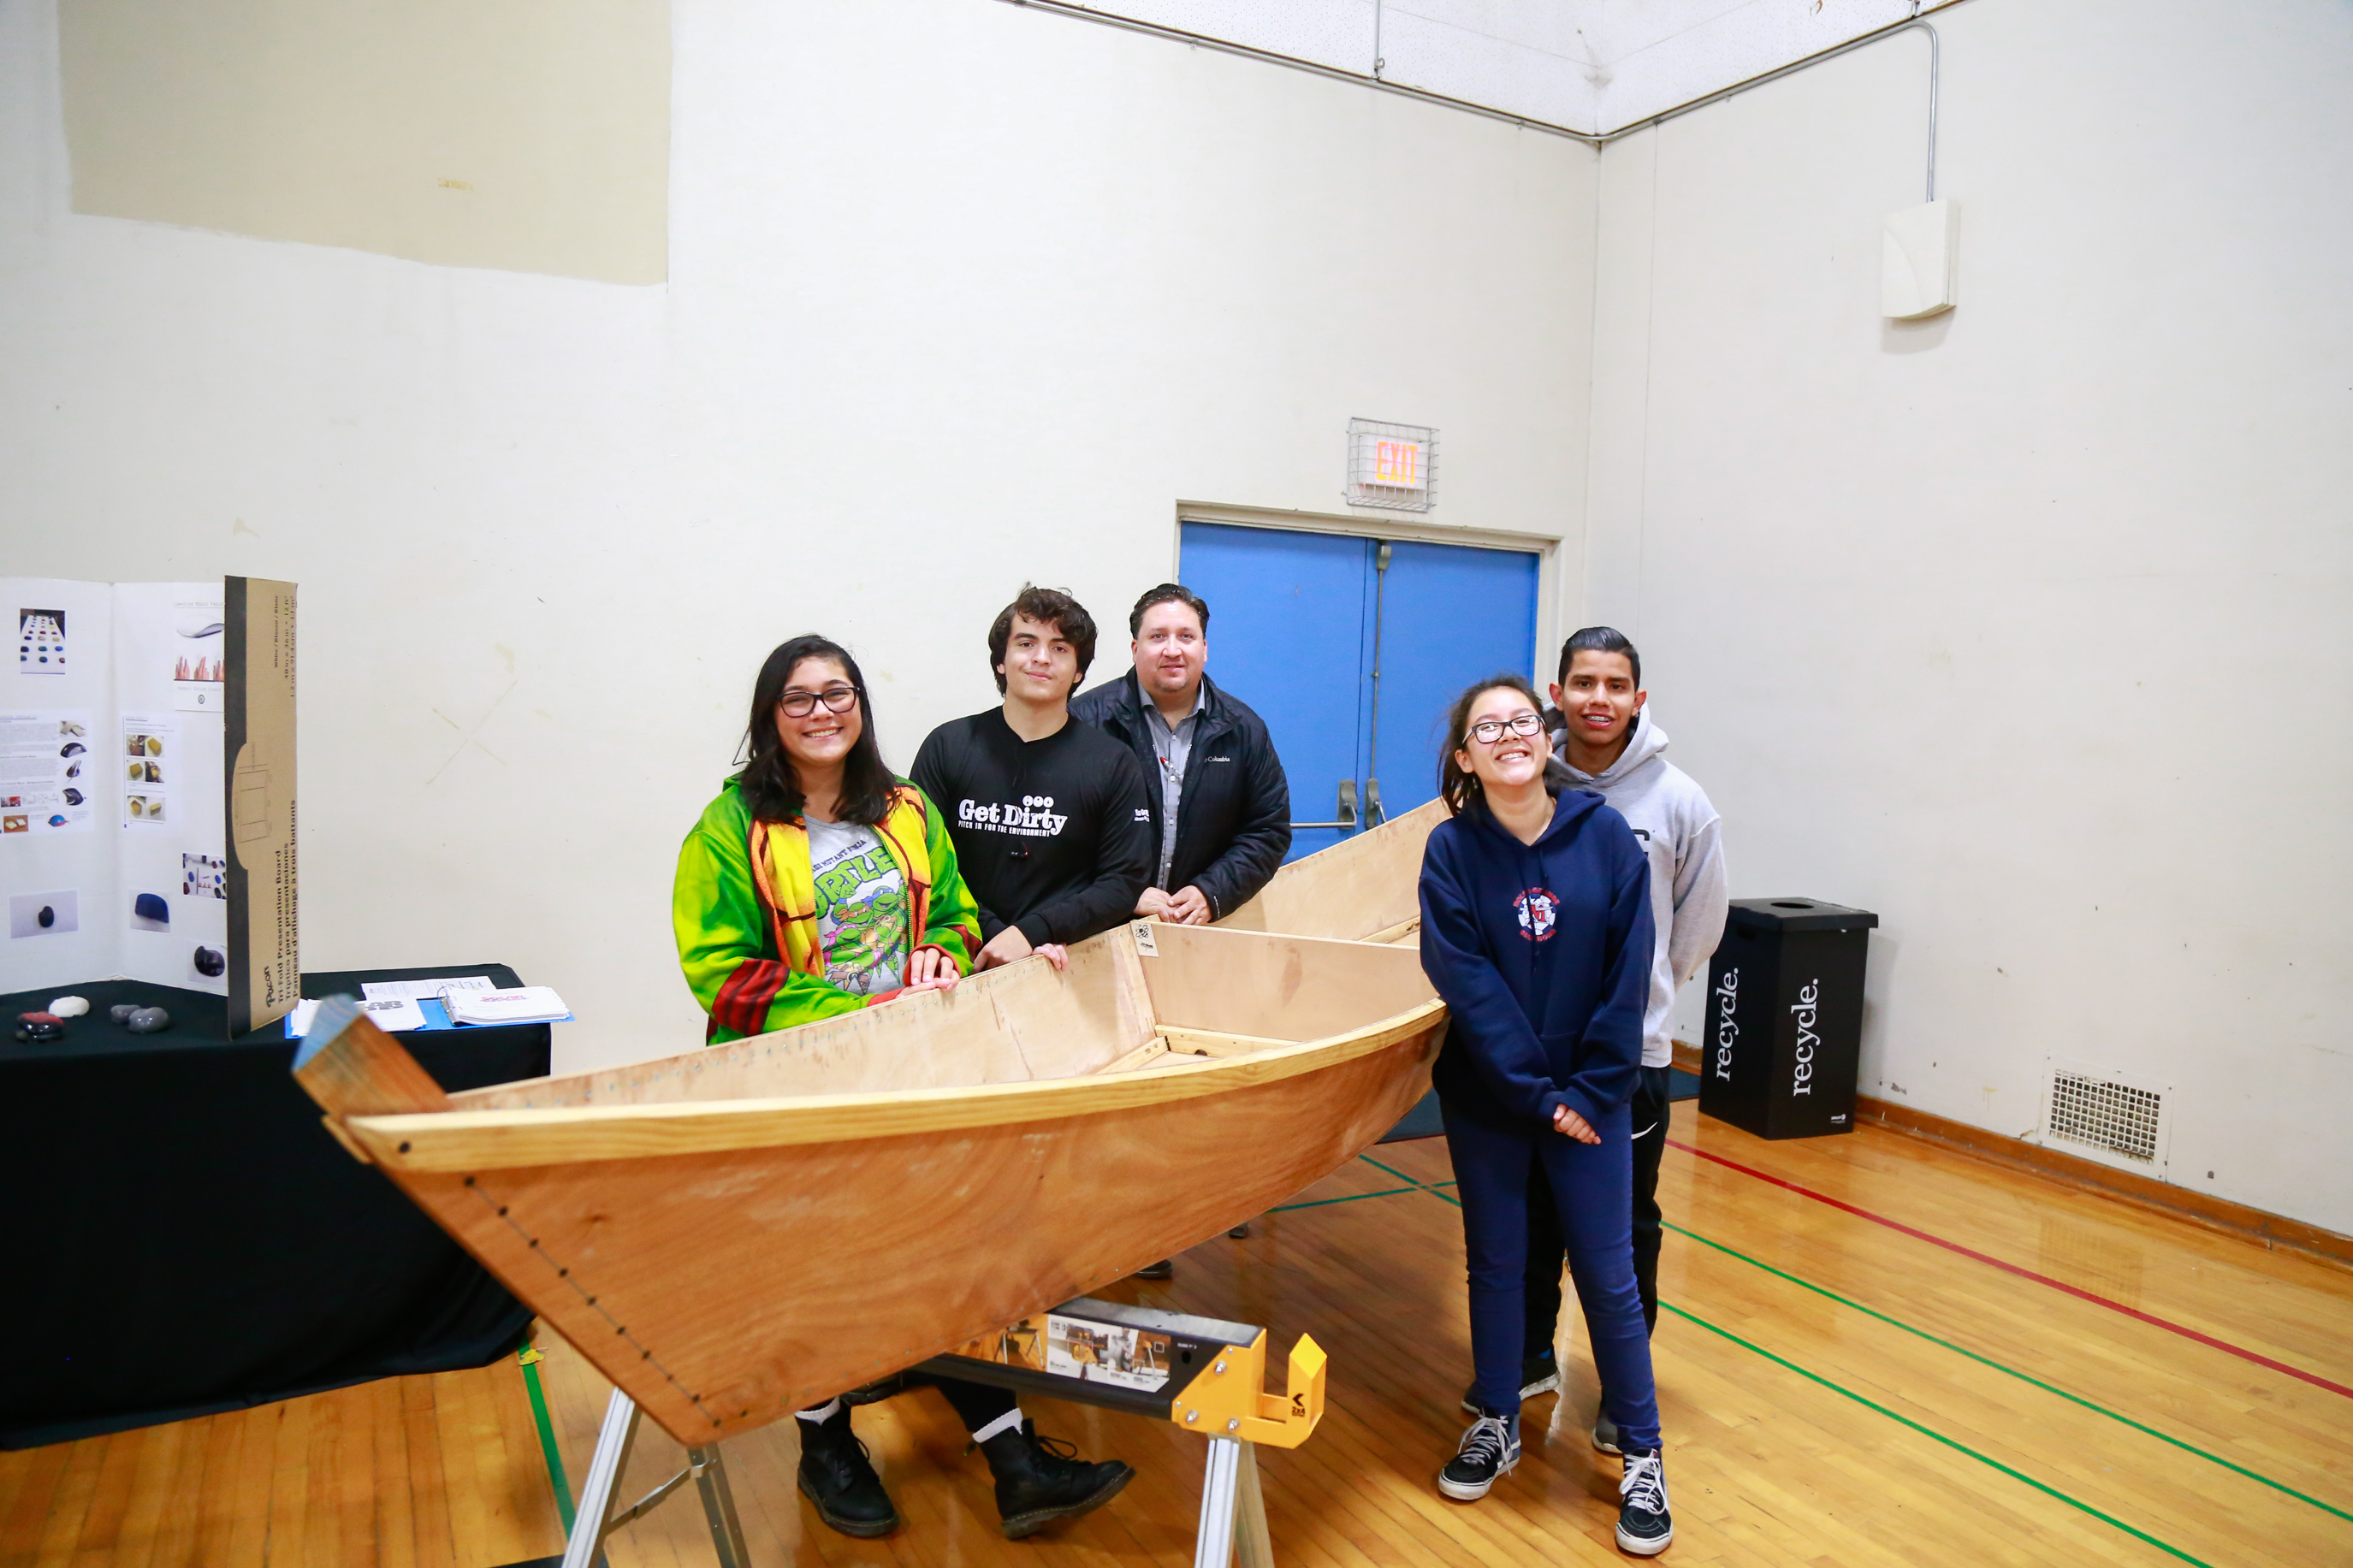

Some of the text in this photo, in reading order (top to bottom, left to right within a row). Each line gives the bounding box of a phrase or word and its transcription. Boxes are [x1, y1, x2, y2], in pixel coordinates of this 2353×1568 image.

[1377, 441, 1420, 484] EXIT
[958, 820, 973, 829] PITCH
[975, 822, 983, 830] IN
[984, 823, 996, 832] FOR
[1009, 828, 1051, 837] ENVIRONMENT
[959, 799, 1068, 836] Get Dirty
[821, 849, 848, 867] MUTANT
[847, 839, 867, 853] NINJA
[264, 966, 276, 1009] Pacon
[1716, 968, 1739, 1081] recycle.
[1791, 979, 1820, 1096] recycle.
